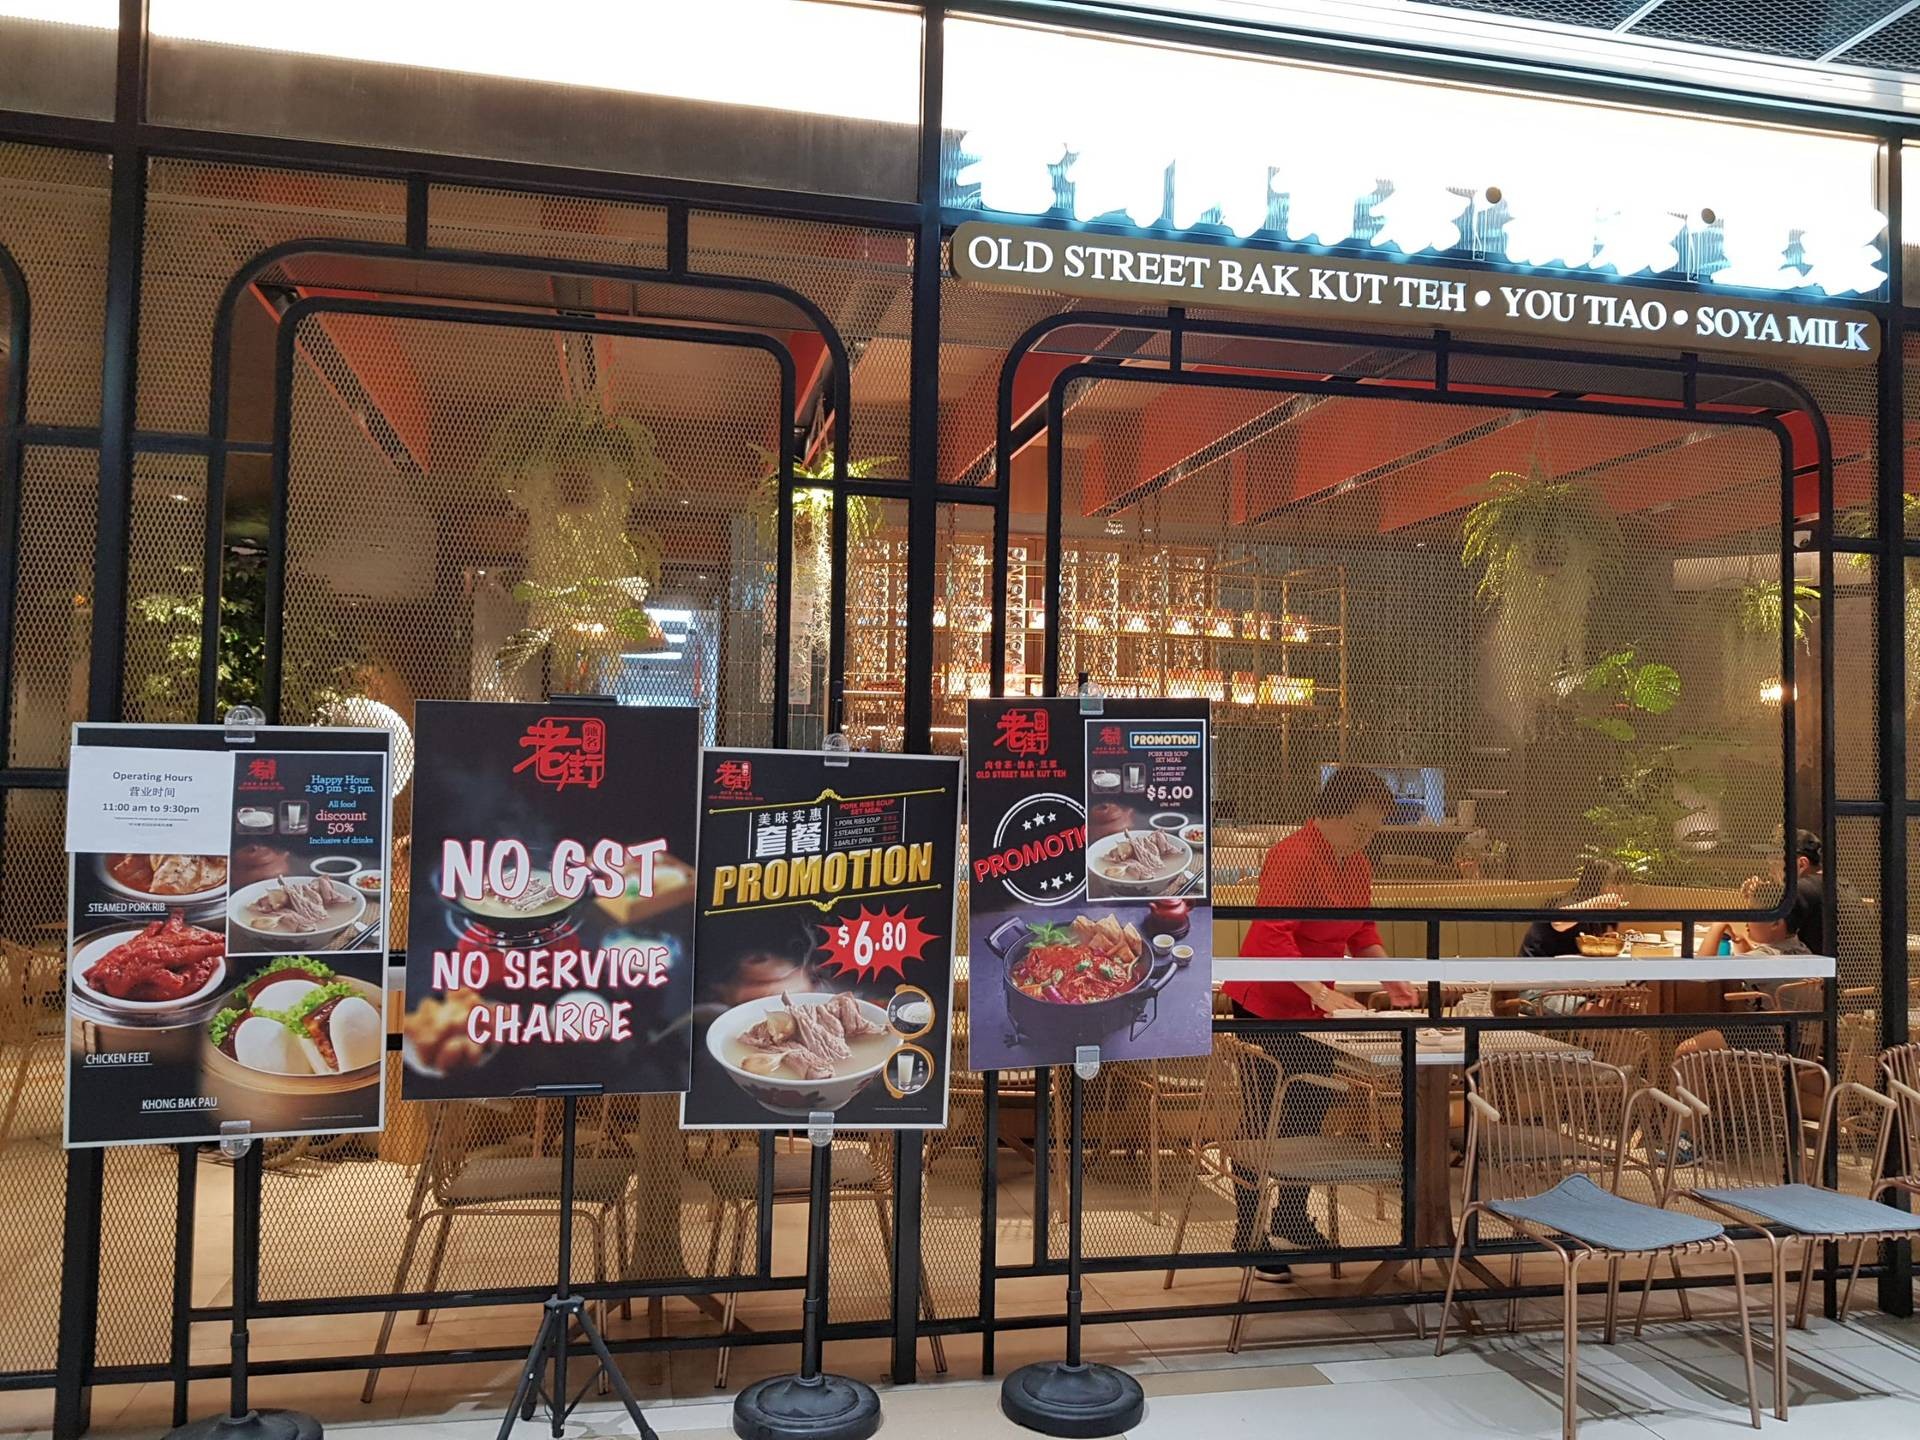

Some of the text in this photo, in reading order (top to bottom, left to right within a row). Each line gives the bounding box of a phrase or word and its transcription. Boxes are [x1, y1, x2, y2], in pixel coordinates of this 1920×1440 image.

[968, 236, 1871, 352] OLD STREET BAK KUT TEH YOU TIAO SOYA MILK
[1133, 734, 1197, 746] PROMOTION
[113, 771, 193, 783] Operating Hours
[311, 774, 370, 786] Happy Hour
[976, 770, 990, 779] OLD
[992, 770, 1018, 778] STREET
[129, 786, 176, 797] 营业时间
[1147, 784, 1193, 801] $5.00
[103, 803, 130, 811] 11:00
[132, 804, 147, 812] am
[163, 805, 200, 814] 9:30pm
[315, 810, 368, 821] discount
[758, 808, 822, 826] 美味实惠
[327, 822, 355, 834] 50%
[351, 836, 374, 844] drinks
[441, 838, 667, 900] NO GST
[712, 842, 932, 906] PROMOTION
[88, 902, 166, 914] STEAMED PORK RIB
[431, 946, 670, 990] NO SERVICE
[466, 1001, 633, 1044] CHARGE
[85, 1052, 150, 1064] CHICKEN FEET
[142, 1097, 218, 1110] KHONG BAK PAU
